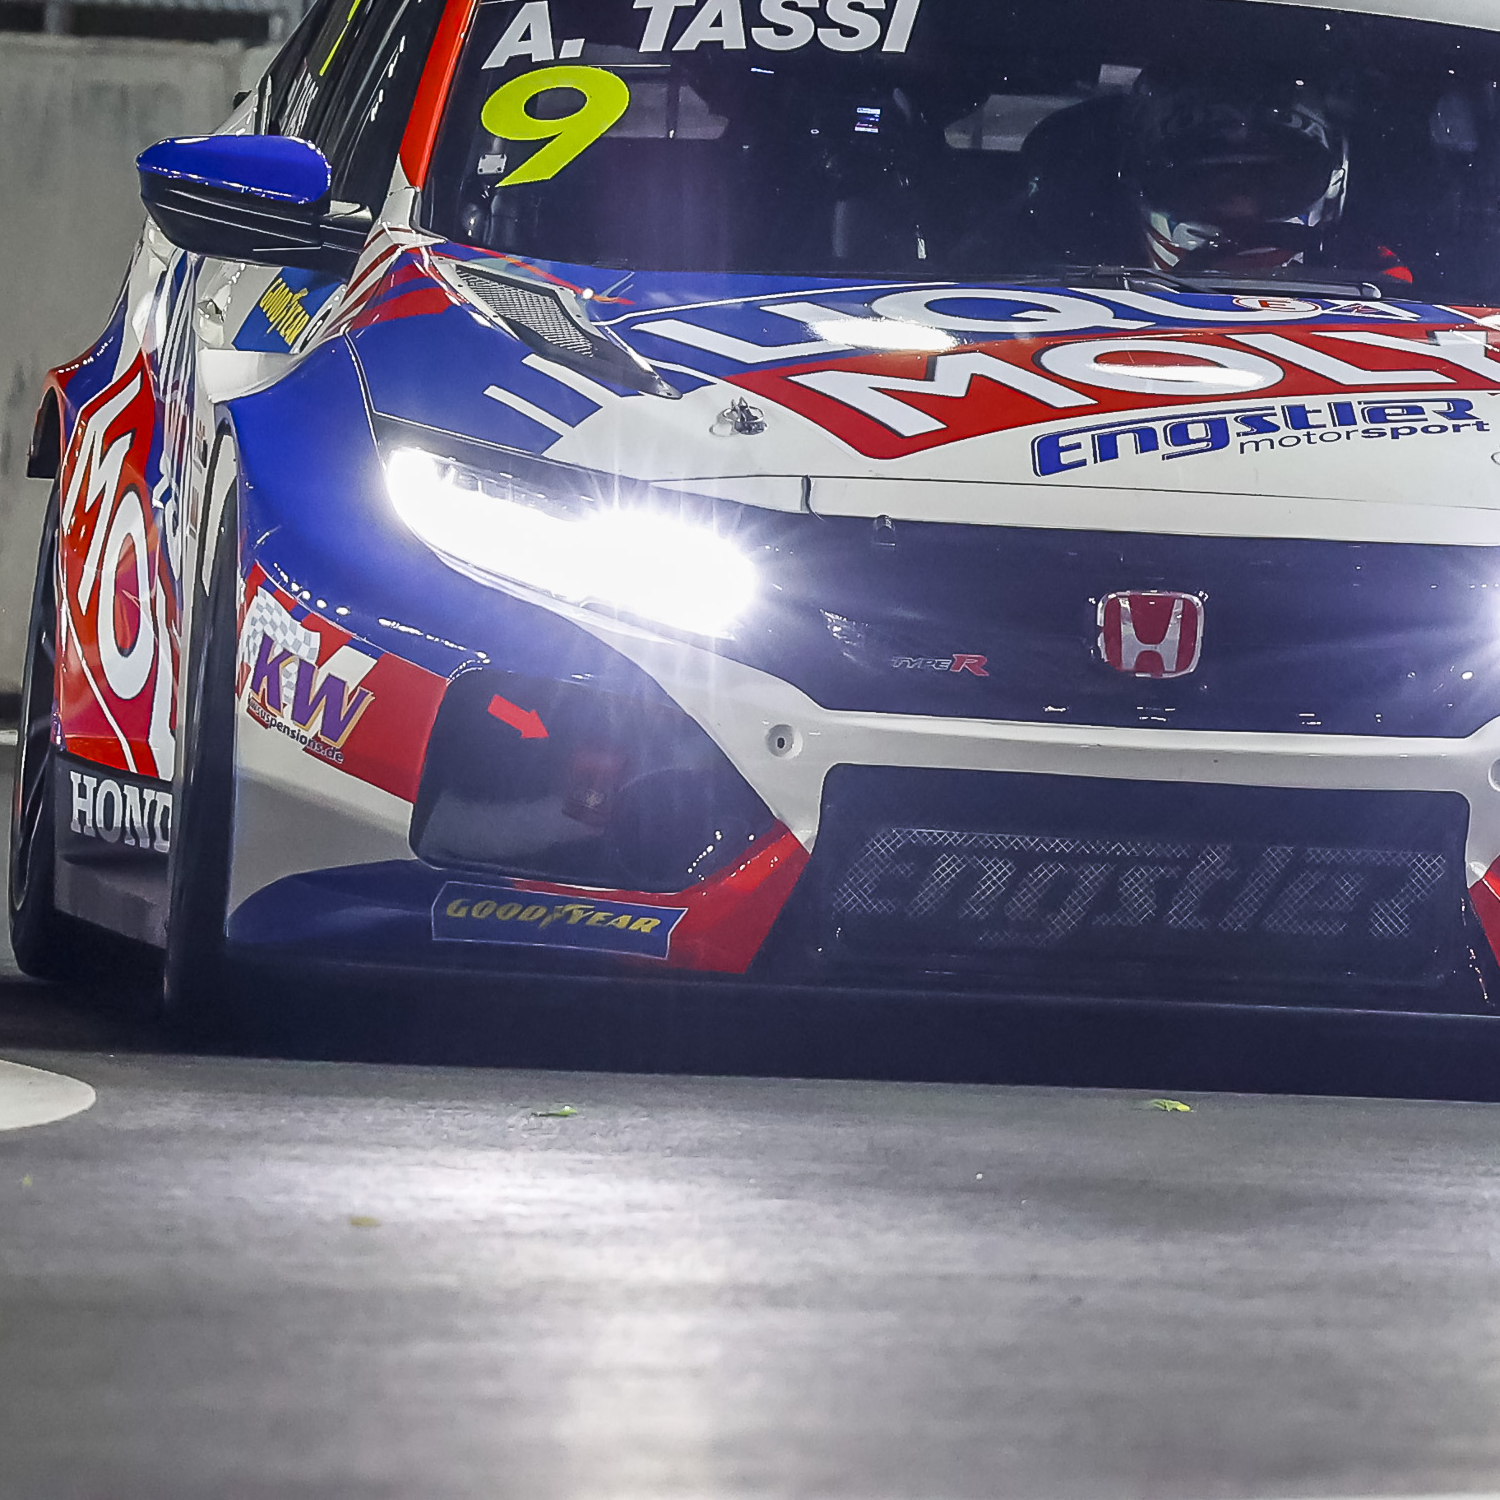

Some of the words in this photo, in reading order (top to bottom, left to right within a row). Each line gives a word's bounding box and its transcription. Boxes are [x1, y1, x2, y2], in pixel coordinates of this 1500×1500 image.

[480, 0, 586, 70] A.
[480, 64, 631, 188] 9
[1030, 397, 1478, 478] Engstler
[1238, 419, 1491, 455] motorsport
[248, 633, 376, 750] KW
[70, 769, 174, 854] HOND
[446, 898, 662, 934] GOODYEAR
